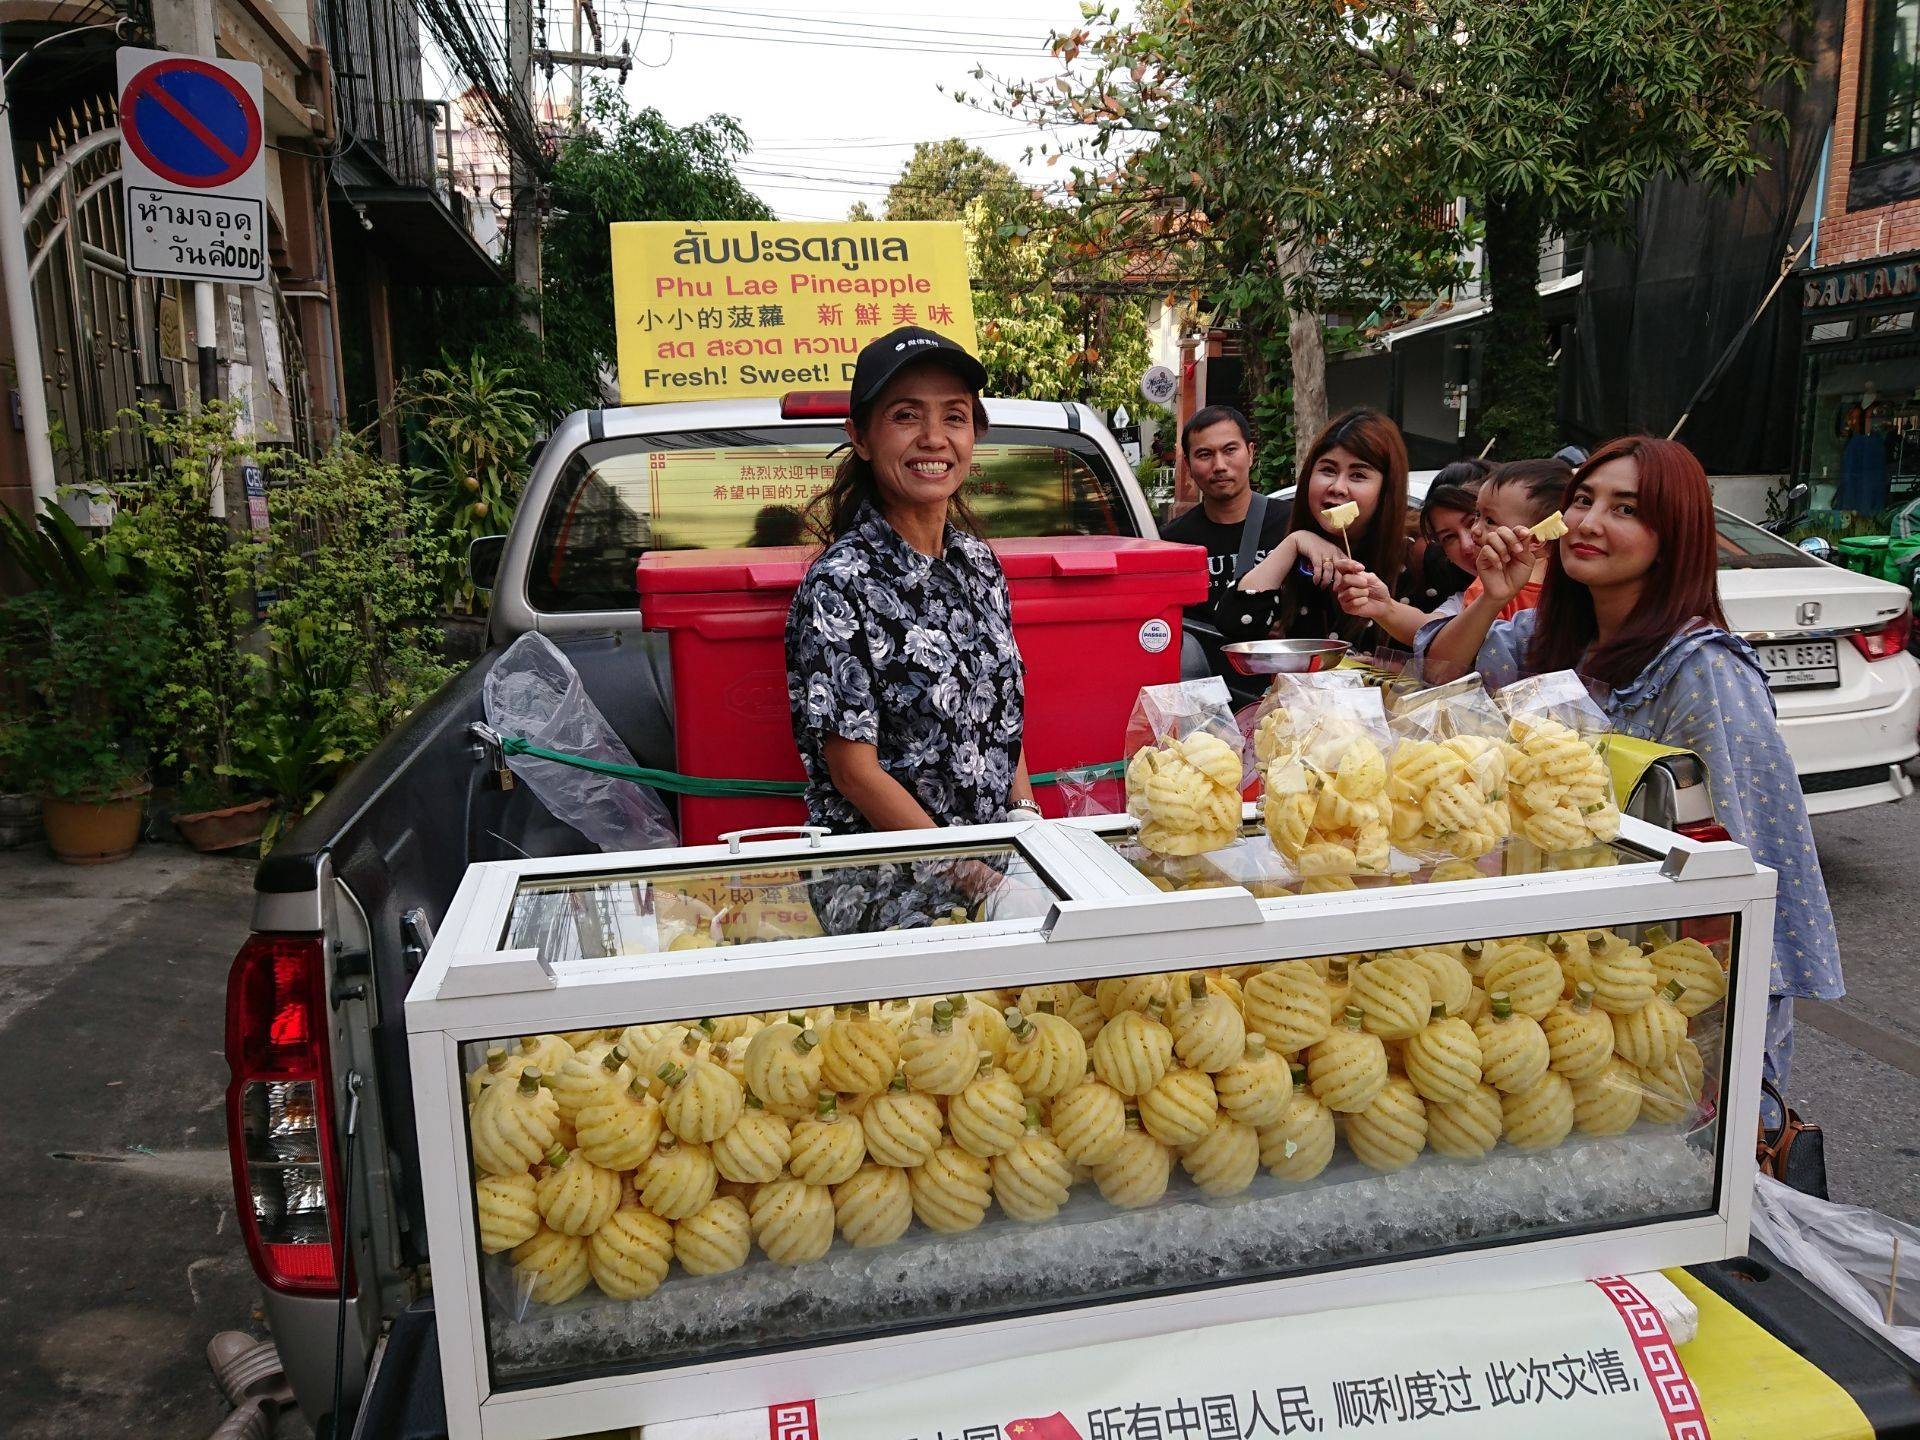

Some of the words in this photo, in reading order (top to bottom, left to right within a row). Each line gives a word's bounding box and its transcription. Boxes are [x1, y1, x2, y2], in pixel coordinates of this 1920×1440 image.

[673, 229, 909, 271] สับปะรดภูแล
[656, 277, 713, 298] Phu
[725, 275, 778, 297] Lae
[790, 273, 932, 298] Pineapple
[636, 303, 786, 332] 小小的菠蘿
[657, 340, 695, 359] สด
[706, 338, 783, 357] สะอาด
[794, 336, 858, 355] หวาน
[644, 366, 727, 388] Fresh!
[739, 363, 830, 385] Sweet!
[713, 484, 832, 501] 希望中国的兄弟
